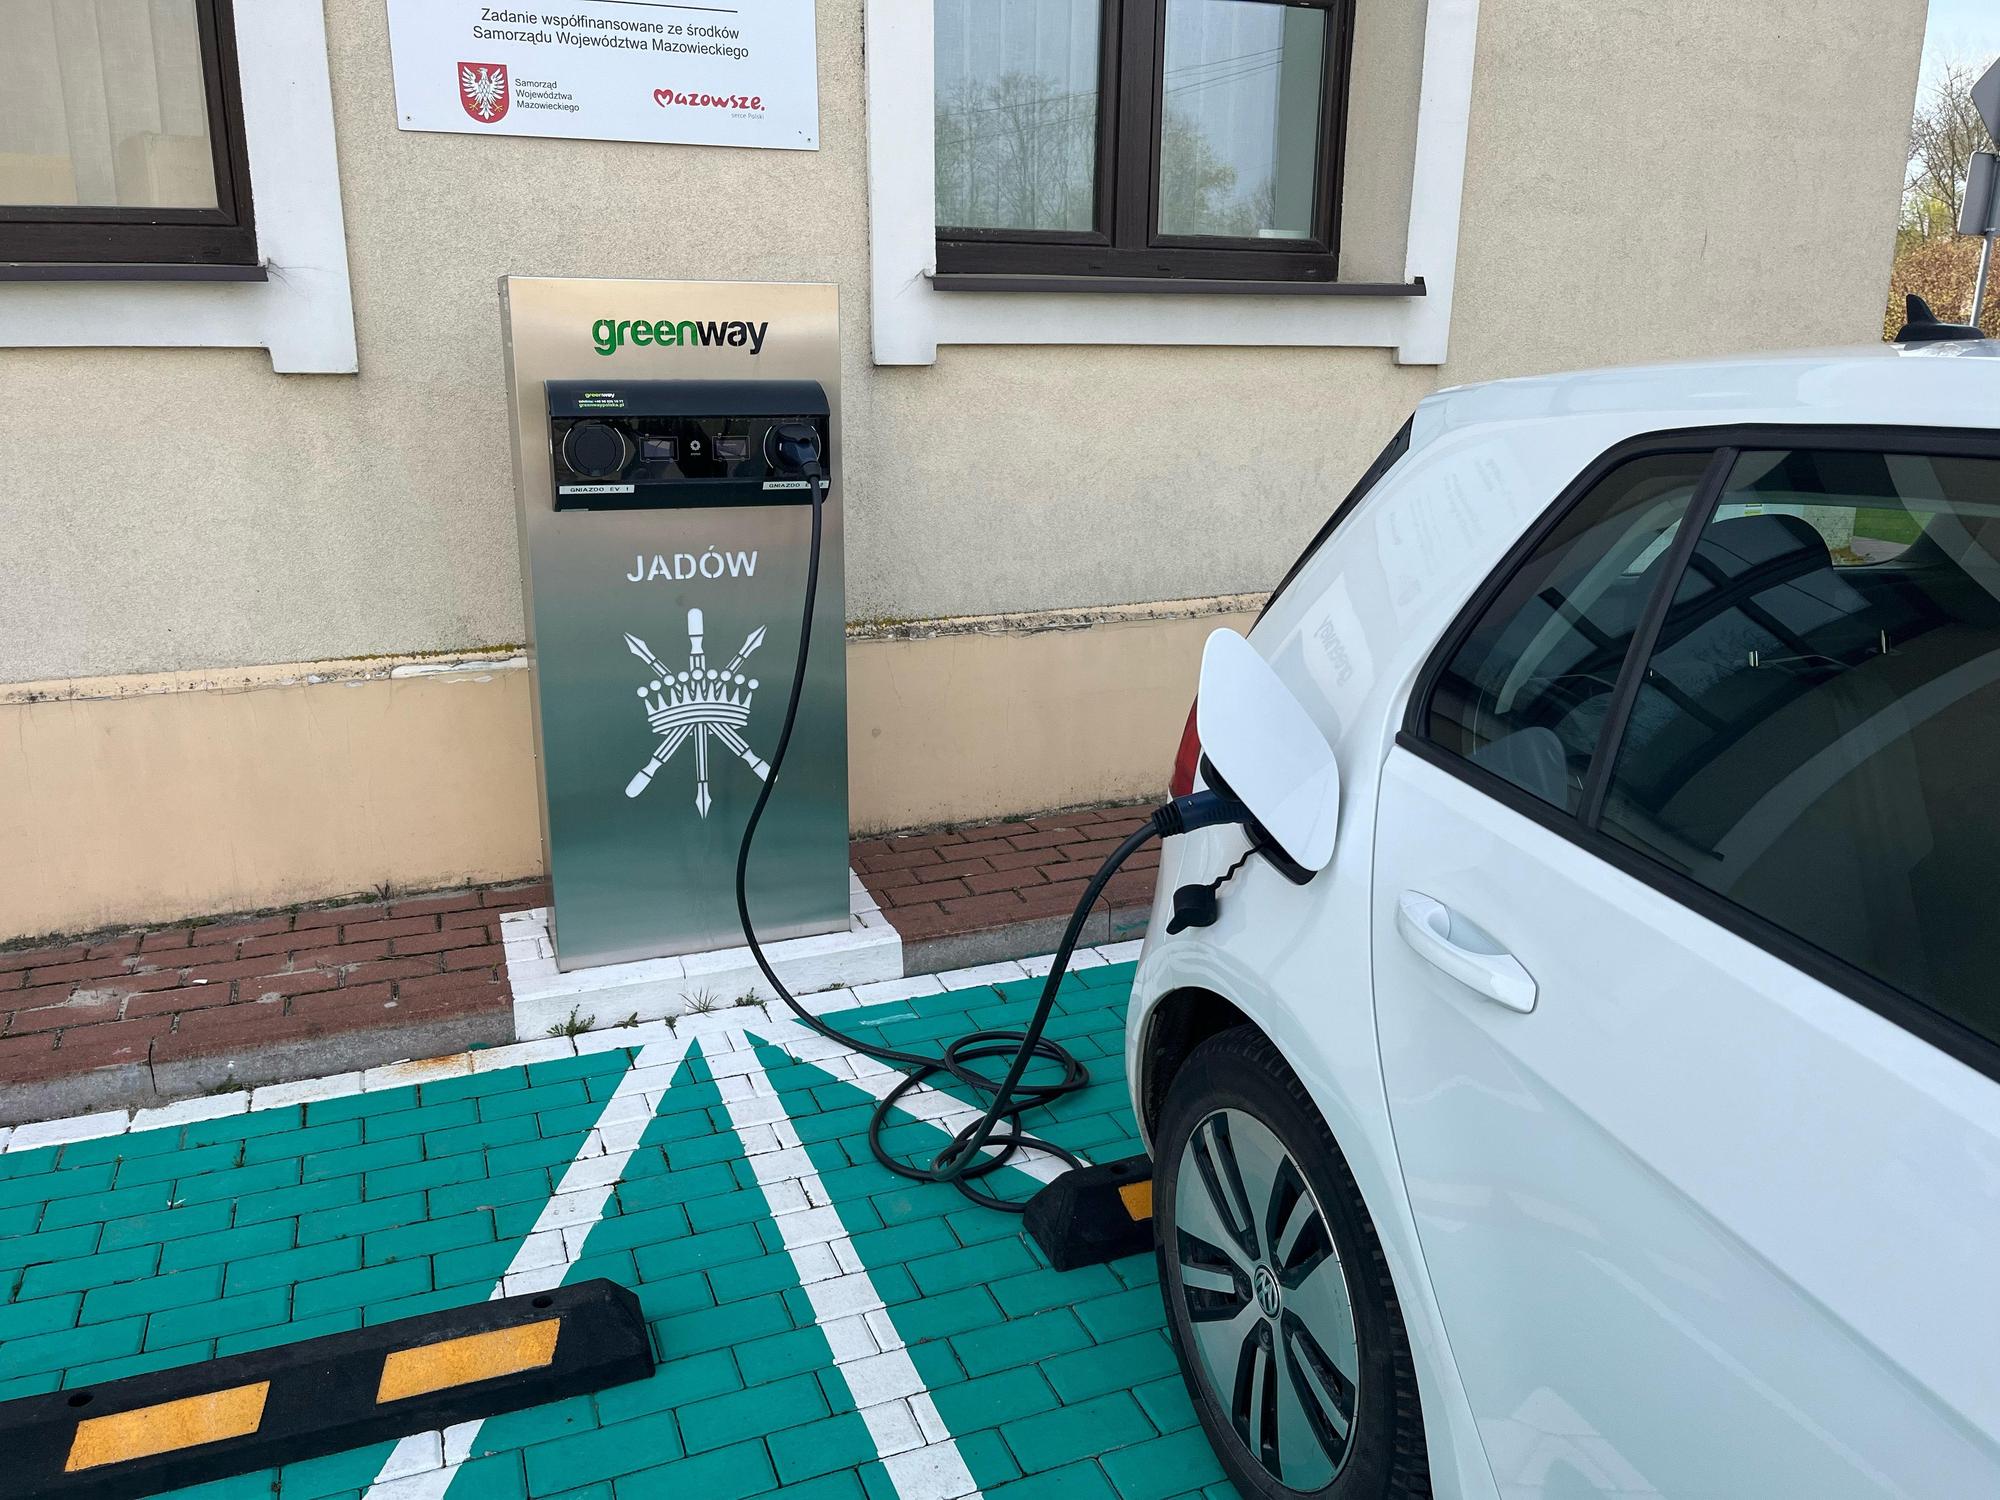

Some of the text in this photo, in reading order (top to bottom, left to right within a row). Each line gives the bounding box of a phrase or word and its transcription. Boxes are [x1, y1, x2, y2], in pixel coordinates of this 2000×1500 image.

[480, 7, 740, 40] Zadanie współfinansowane ze środków
[473, 25, 749, 60] Samorządu Województwa Mazowieckiego
[514, 78, 558, 91] Samorząd
[515, 89, 573, 101] Województwa
[516, 100, 580, 113] Mazowieckiego
[747, 112, 765, 120] Polski
[591, 318, 769, 357] greenway
[626, 545, 758, 583] JADÓW
